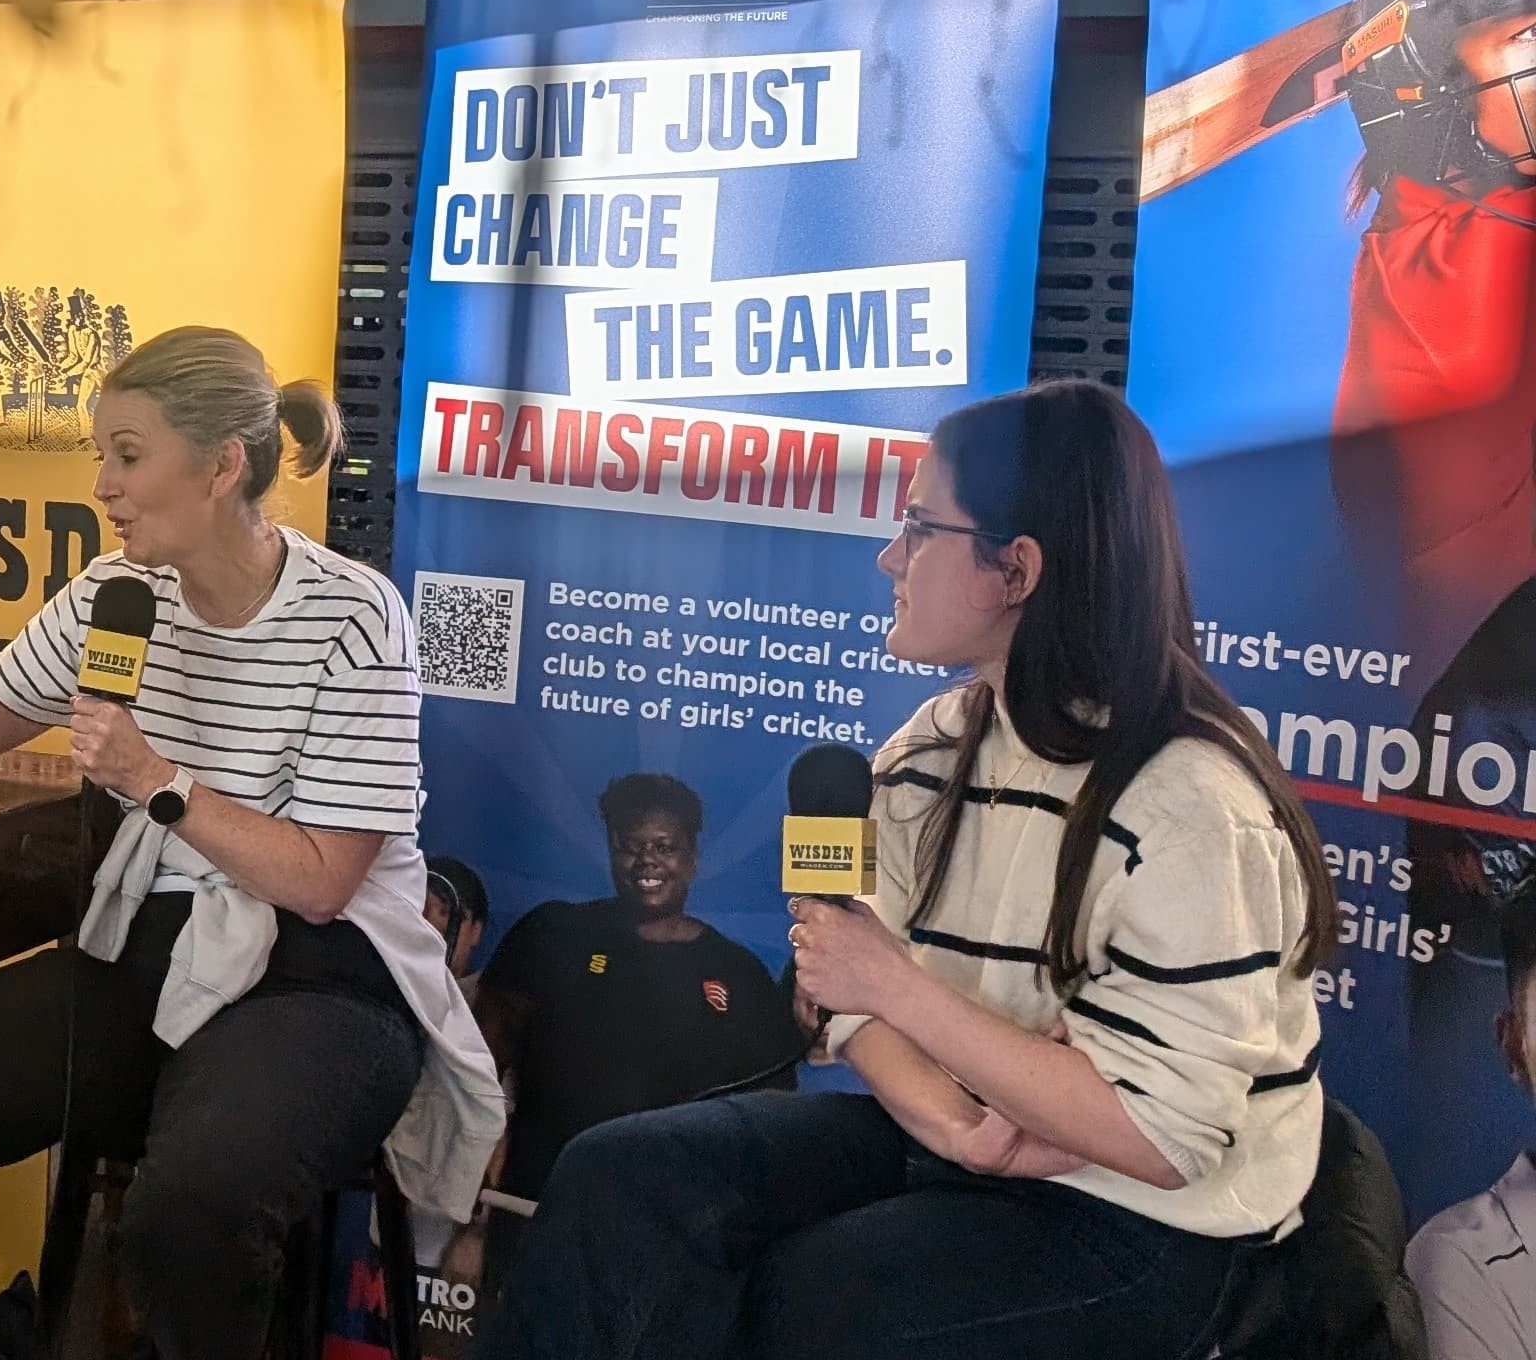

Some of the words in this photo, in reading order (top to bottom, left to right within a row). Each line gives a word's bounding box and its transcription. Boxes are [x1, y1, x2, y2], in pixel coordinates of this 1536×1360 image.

[645, 12, 721, 24] CHAMPIONING
[723, 12, 744, 22] THE
[746, 10, 788, 22] FUTURE
[464, 78, 649, 165] DON'T
[665, 66, 832, 154] JUST
[443, 193, 681, 270] CHANGE
[593, 301, 713, 382] THE
[735, 286, 954, 377] GAME.
[433, 397, 840, 515] TRANSFORM
[549, 581, 670, 614] Become
[678, 597, 697, 616] a
[706, 597, 852, 631] volunteer
[859, 614, 895, 635] or
[87, 649, 137, 670] WISDEN
[545, 621, 633, 647] coach
[642, 627, 673, 650] at
[681, 632, 751, 657] your
[759, 635, 831, 666] local
[543, 652, 606, 679] club
[616, 658, 647, 683] to
[656, 662, 805, 700] champion
[814, 679, 864, 707] the
[540, 685, 630, 717] future
[639, 697, 672, 721] of
[680, 700, 754, 729] girls’
[762, 711, 874, 745] cricket.
[1238, 706, 1536, 814] mpio
[788, 844, 854, 861] WISDEN
